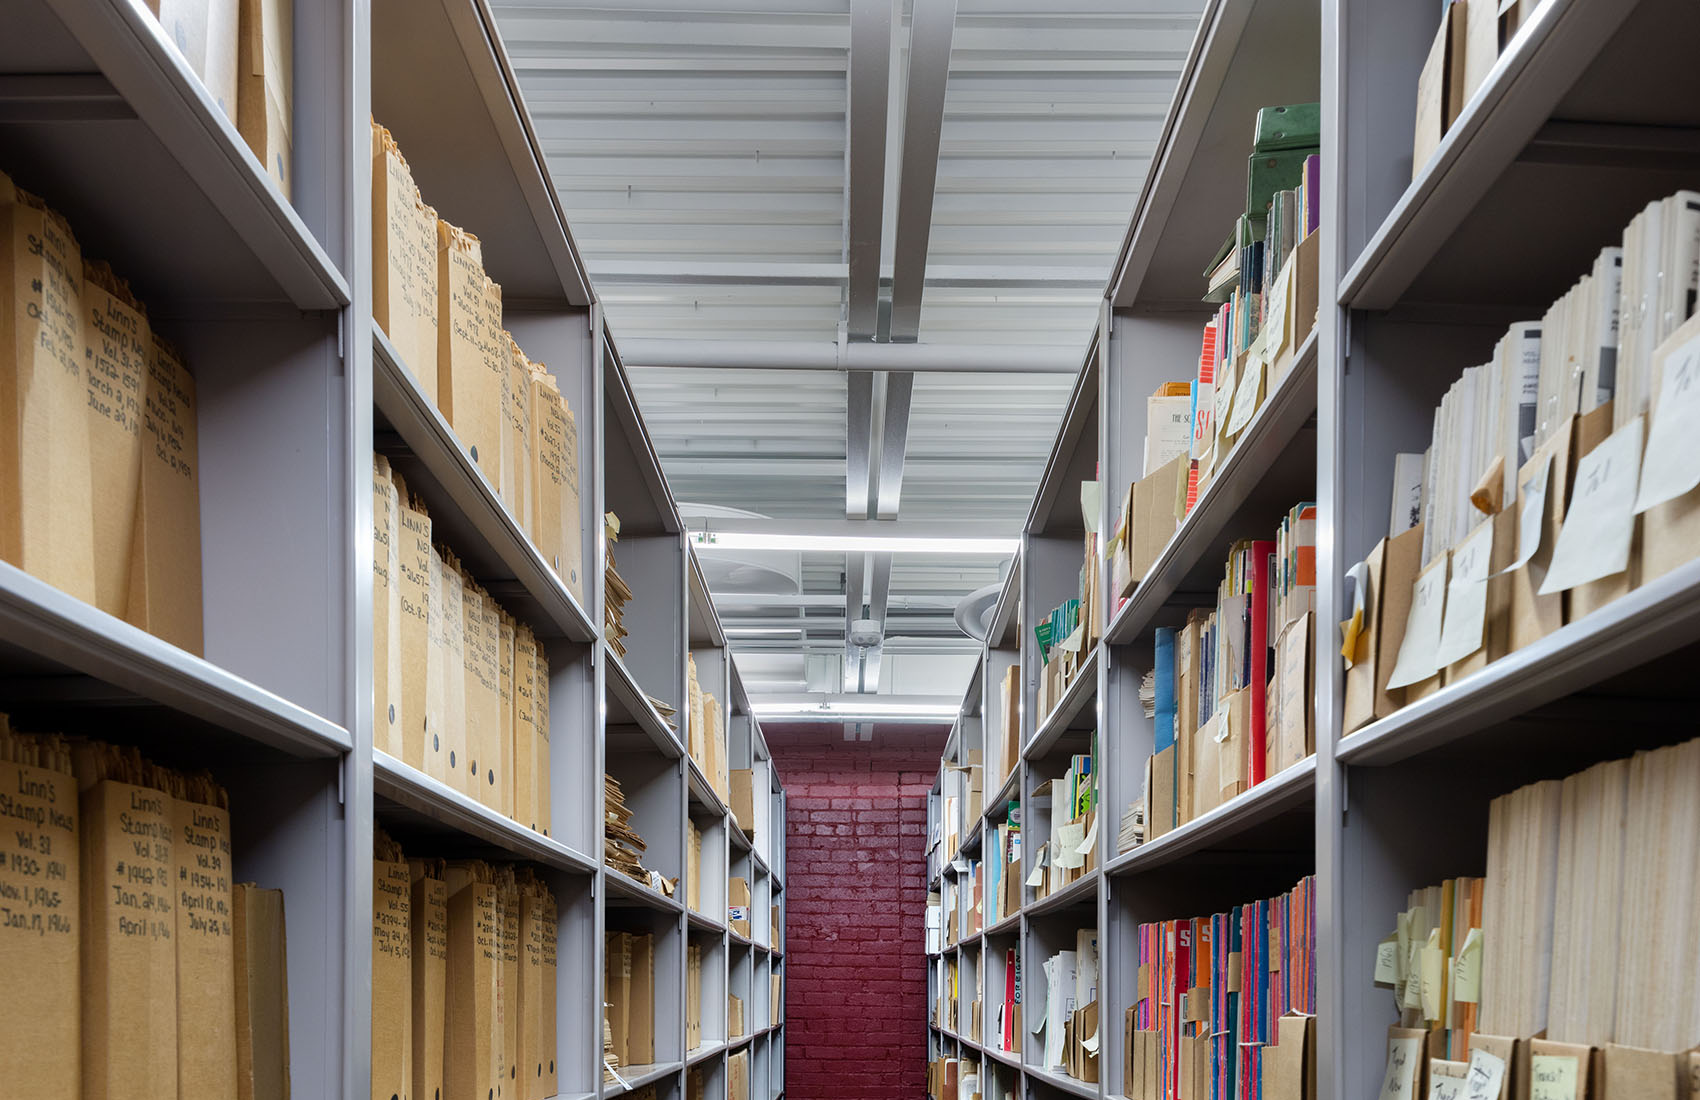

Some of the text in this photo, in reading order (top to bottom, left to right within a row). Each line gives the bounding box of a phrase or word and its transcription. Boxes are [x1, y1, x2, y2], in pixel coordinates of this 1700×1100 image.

[92, 308, 128, 348] Stamp
[108, 299, 137, 335] Linn's
[87, 389, 111, 418] June
[402, 510, 430, 538] LINN'S
[18, 769, 56, 803] Linn's
[0, 793, 45, 829] Stamp
[131, 790, 162, 816] Linn's
[120, 811, 157, 841] Stamp
[193, 808, 220, 833] Linn's
[16, 831, 36, 851] Vol.
[184, 825, 217, 854] Stamp
[112, 885, 141, 909] Jan.
[182, 891, 204, 910] April
[119, 916, 147, 937] April
[189, 912, 207, 936] July
